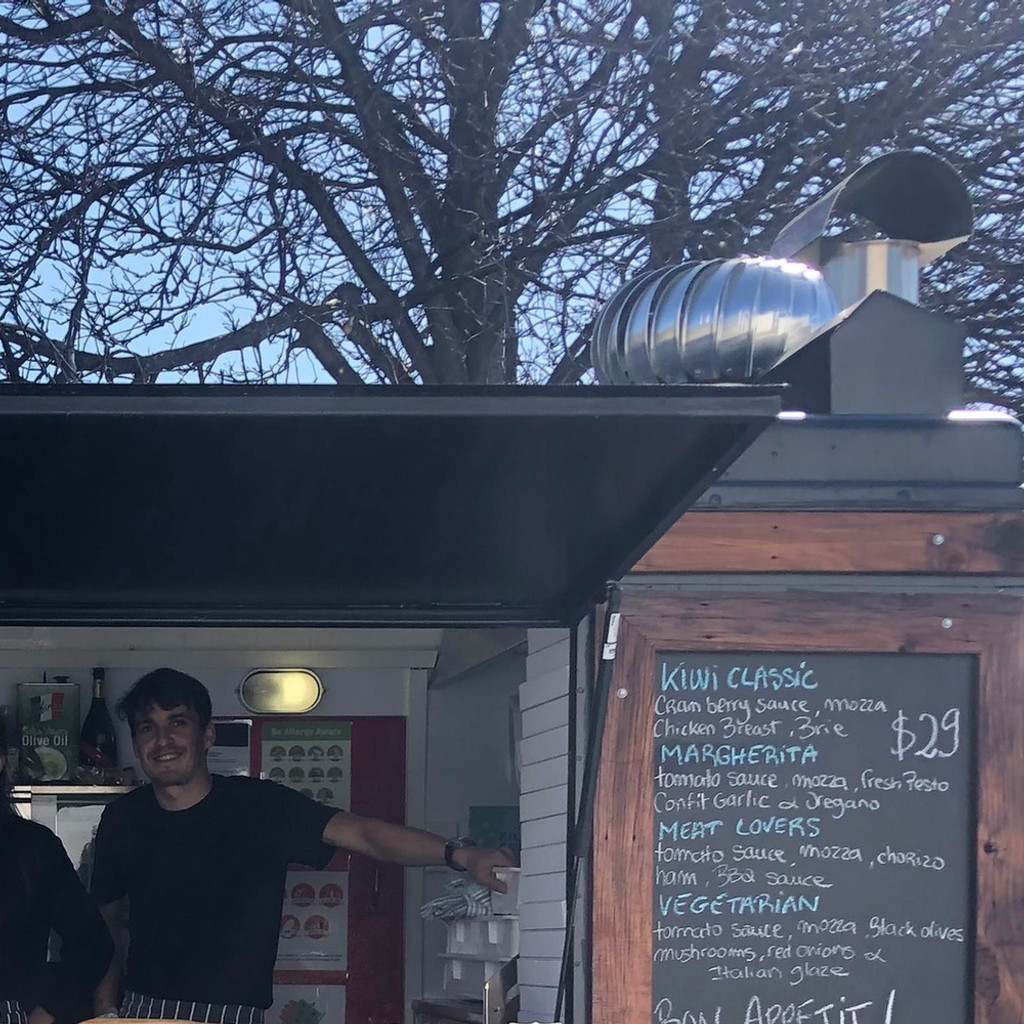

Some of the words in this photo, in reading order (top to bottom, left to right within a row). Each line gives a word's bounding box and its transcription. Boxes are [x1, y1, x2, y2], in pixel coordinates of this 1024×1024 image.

[823, 697, 888, 713] mozza
[652, 717, 717, 738] Chicken
[890, 707, 960, 761] $29
[22, 734, 50, 746] Olive
[53, 733, 69, 746] Oil
[653, 765, 721, 789] tomato
[653, 791, 710, 814] Confit
[712, 789, 772, 810] Garlic
[805, 791, 881, 819] Oregano
[658, 819, 724, 842] MEAT
[735, 816, 821, 838] LOVERS
[654, 842, 725, 863] tomato
[764, 870, 834, 889] sauce
[652, 920, 723, 941] tomato
[919, 920, 966, 943] olives
[766, 944, 791, 960] red
[795, 942, 856, 961] onions
[707, 963, 783, 982] Italian
[789, 961, 850, 987] glaze
